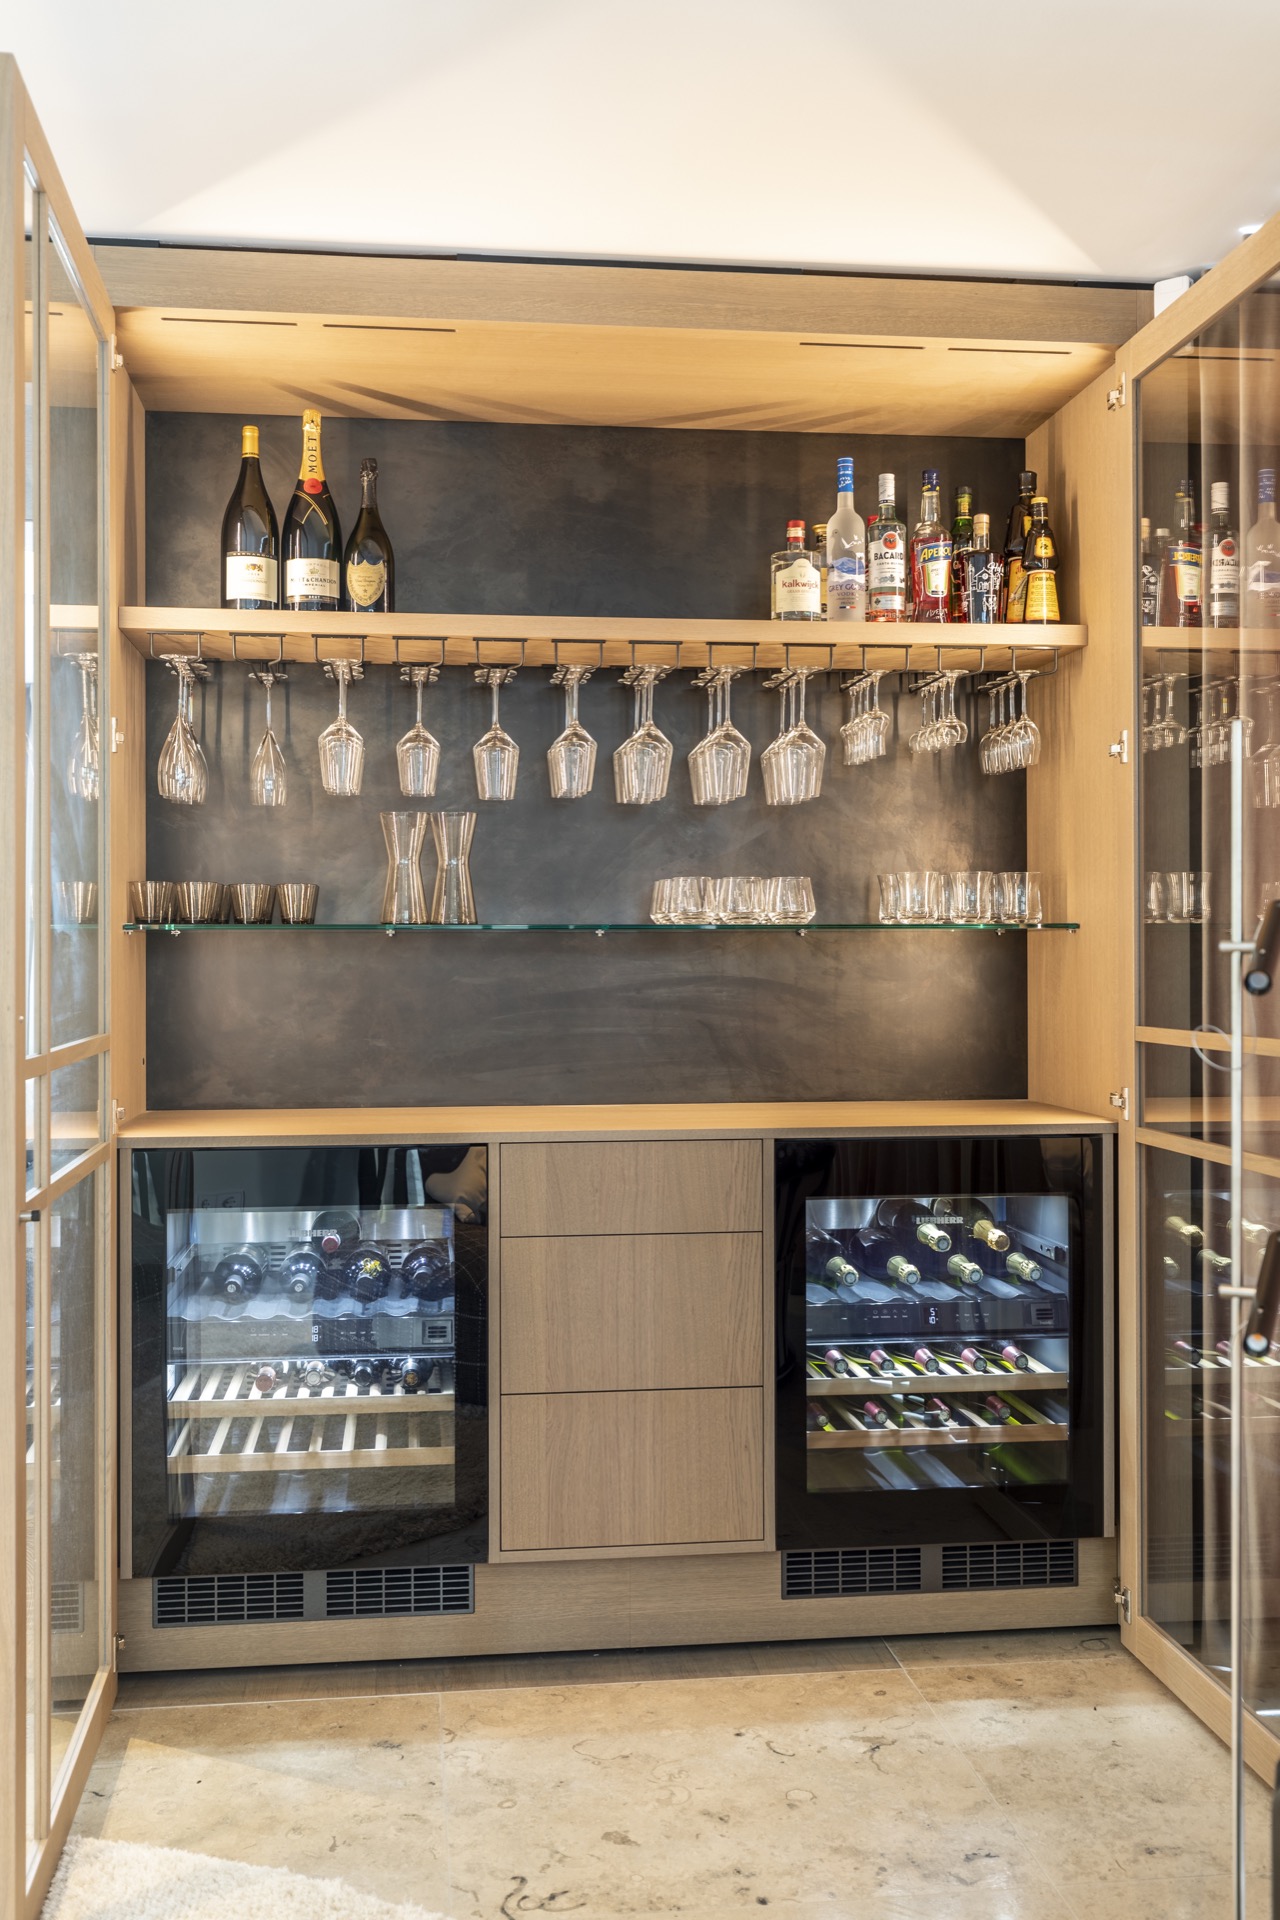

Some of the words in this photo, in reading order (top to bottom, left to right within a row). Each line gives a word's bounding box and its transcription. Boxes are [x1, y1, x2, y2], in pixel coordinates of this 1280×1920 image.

[874, 552, 903, 560] BACARD
[920, 546, 951, 562] APEROL
[829, 584, 843, 592] GREY
